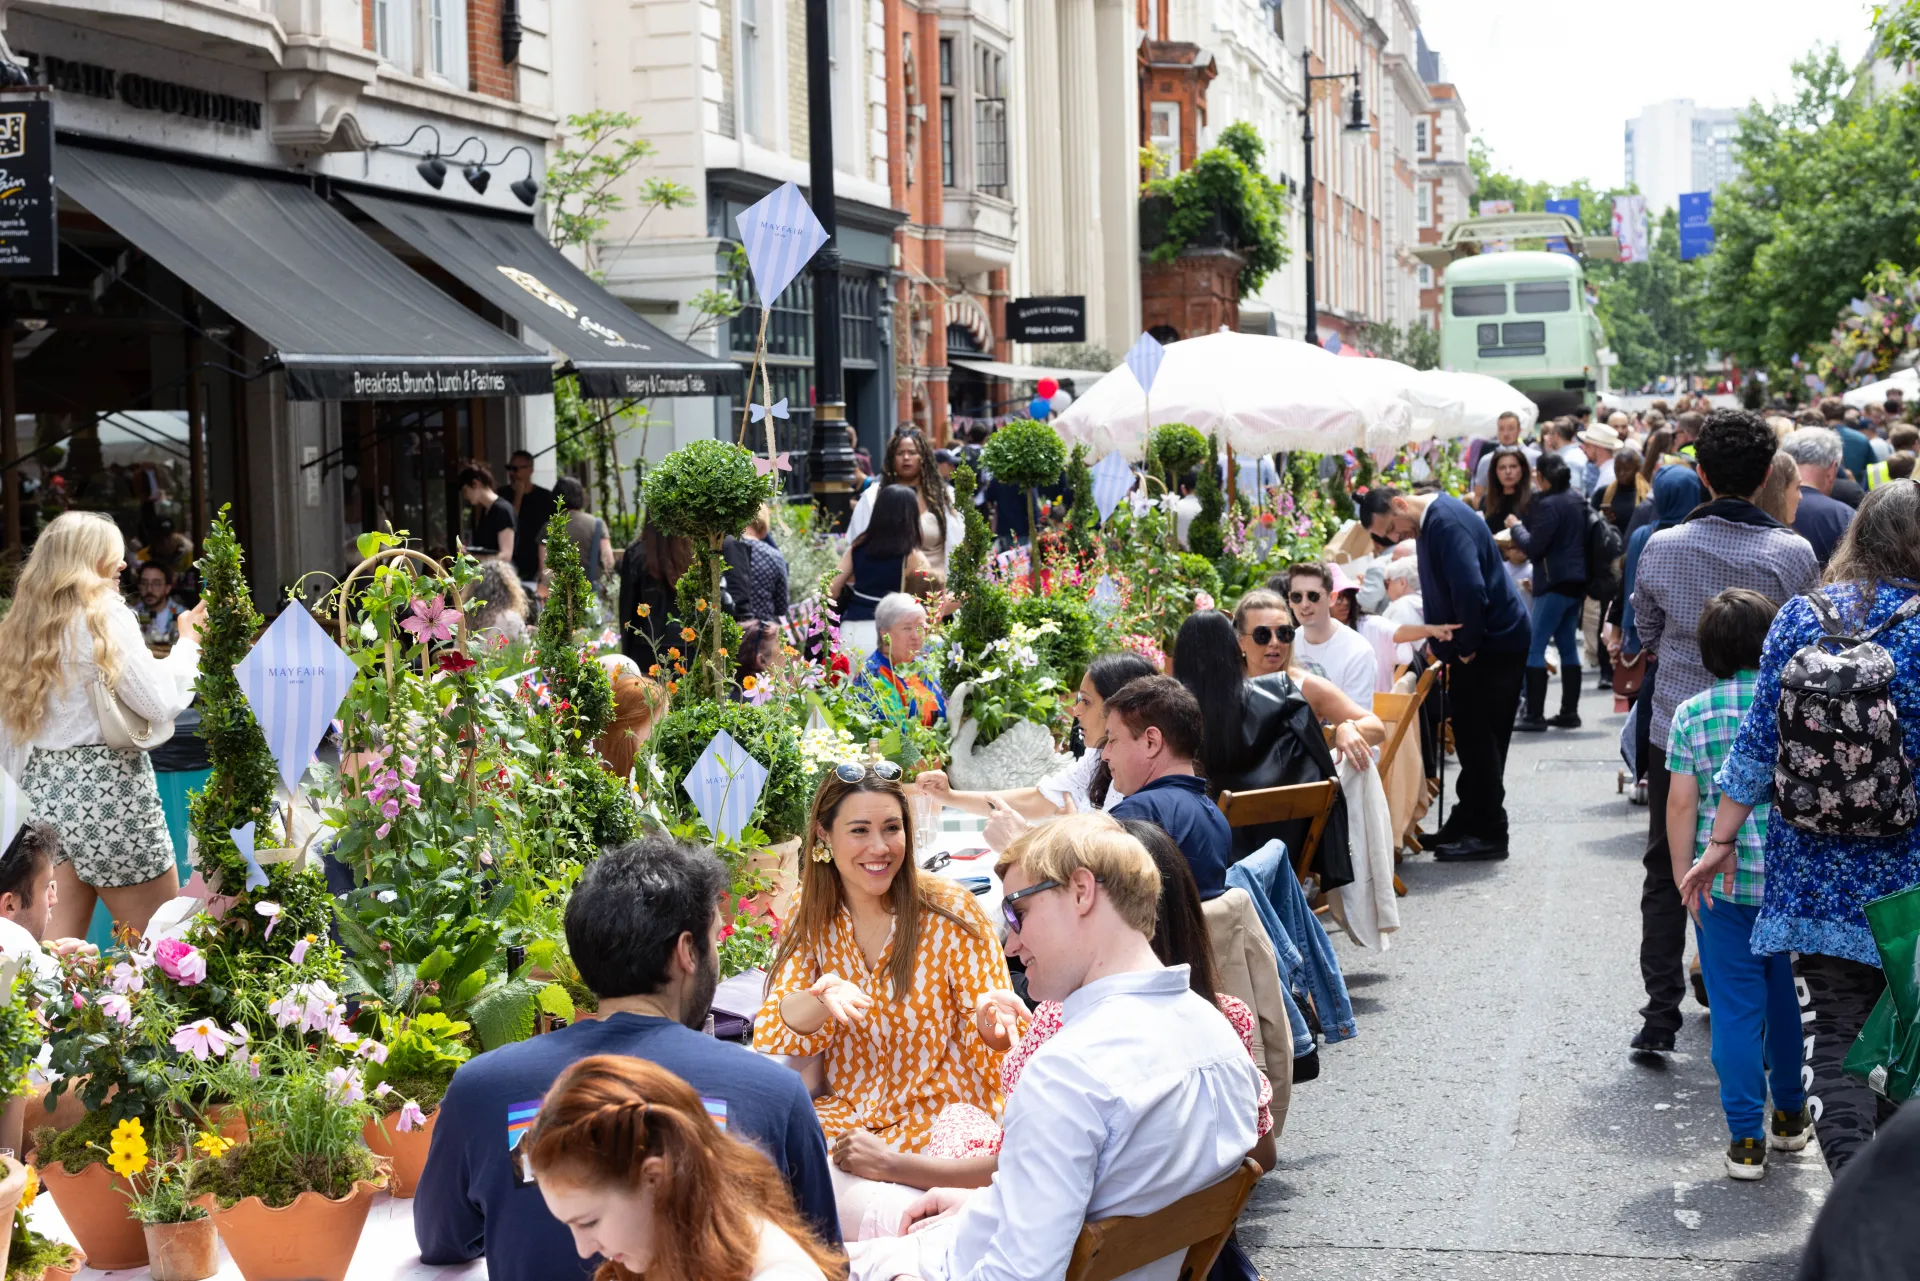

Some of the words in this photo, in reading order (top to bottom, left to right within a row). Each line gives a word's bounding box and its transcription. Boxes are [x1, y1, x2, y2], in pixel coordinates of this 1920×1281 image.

[45, 55, 116, 100] PAIN
[118, 72, 262, 130] QUOTIDIEN
[2, 198, 38, 206] IDIEN
[760, 221, 803, 235] MAYFAIR
[1050, 325, 1074, 334] CHIPS
[437, 370, 462, 392] Lunch
[463, 369, 470, 391] &
[471, 369, 505, 391] Pastries
[268, 667, 325, 676] MAYFAIR
